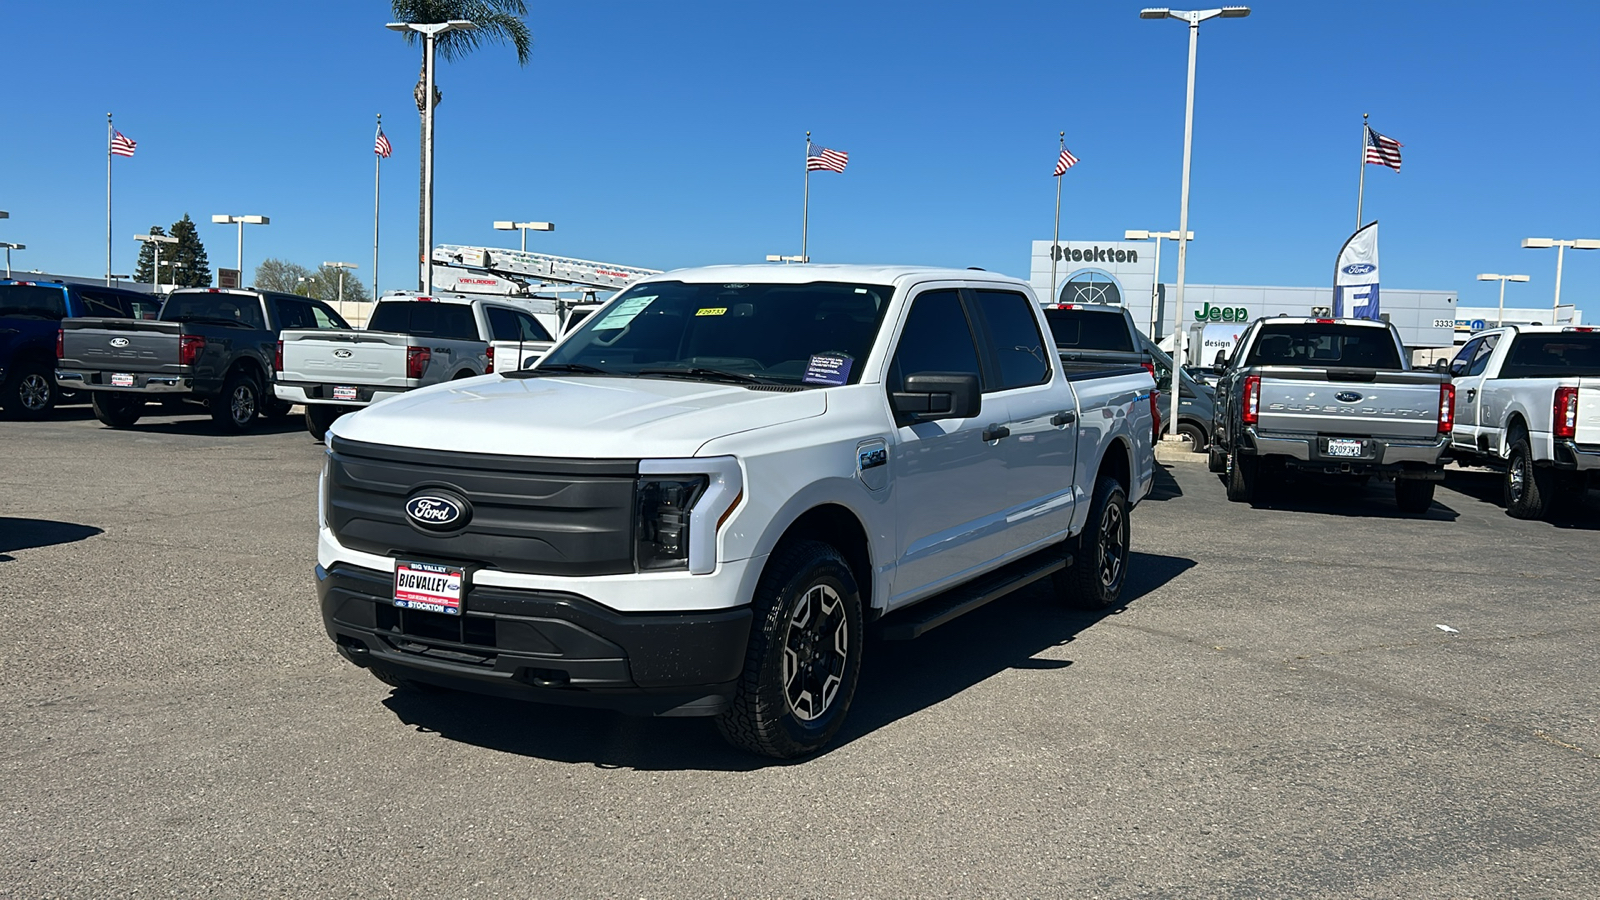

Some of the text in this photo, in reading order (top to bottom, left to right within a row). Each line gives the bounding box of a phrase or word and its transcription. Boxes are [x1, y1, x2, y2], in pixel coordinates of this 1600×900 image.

[1050, 246, 1138, 263] Stockton
[1194, 302, 1249, 323] Jeep
[1434, 320, 1454, 328] 3333
[1204, 340, 1231, 348] design
[1269, 403, 1429, 417] SUPER DUTY
[414, 499, 450, 520] Ford
[423, 564, 446, 572] VALLEY
[399, 573, 448, 593] BIGVALLEY
[408, 601, 445, 612] STOCKTON
